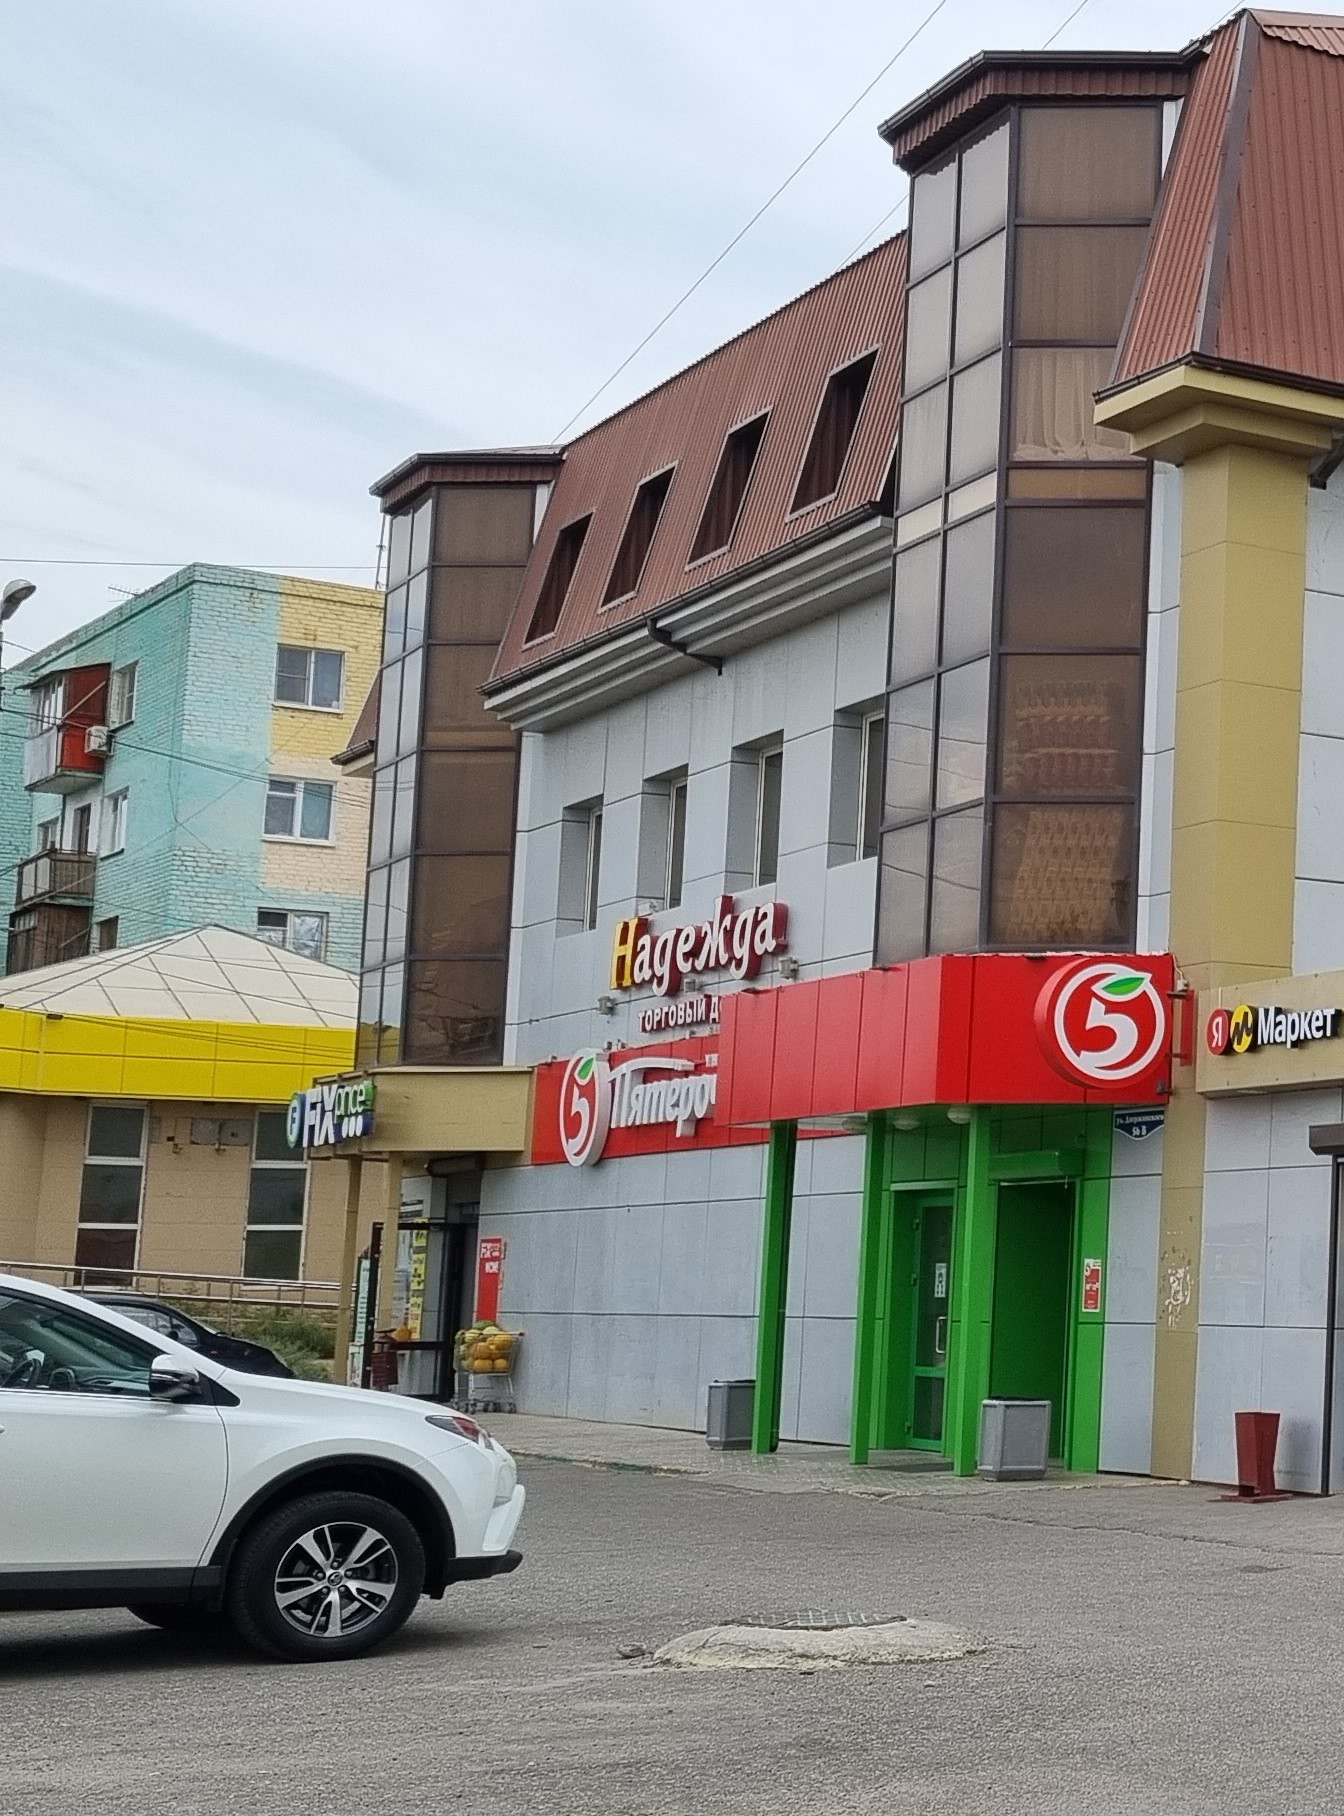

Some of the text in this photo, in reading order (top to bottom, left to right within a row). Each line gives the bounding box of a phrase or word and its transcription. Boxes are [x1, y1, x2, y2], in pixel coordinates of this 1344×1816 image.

[609, 894, 789, 997] Надежда
[638, 997, 706, 1032] ТОРГОВЫЙ
[1079, 996, 1138, 1068] 5
[1257, 1006, 1337, 1048] Маркет
